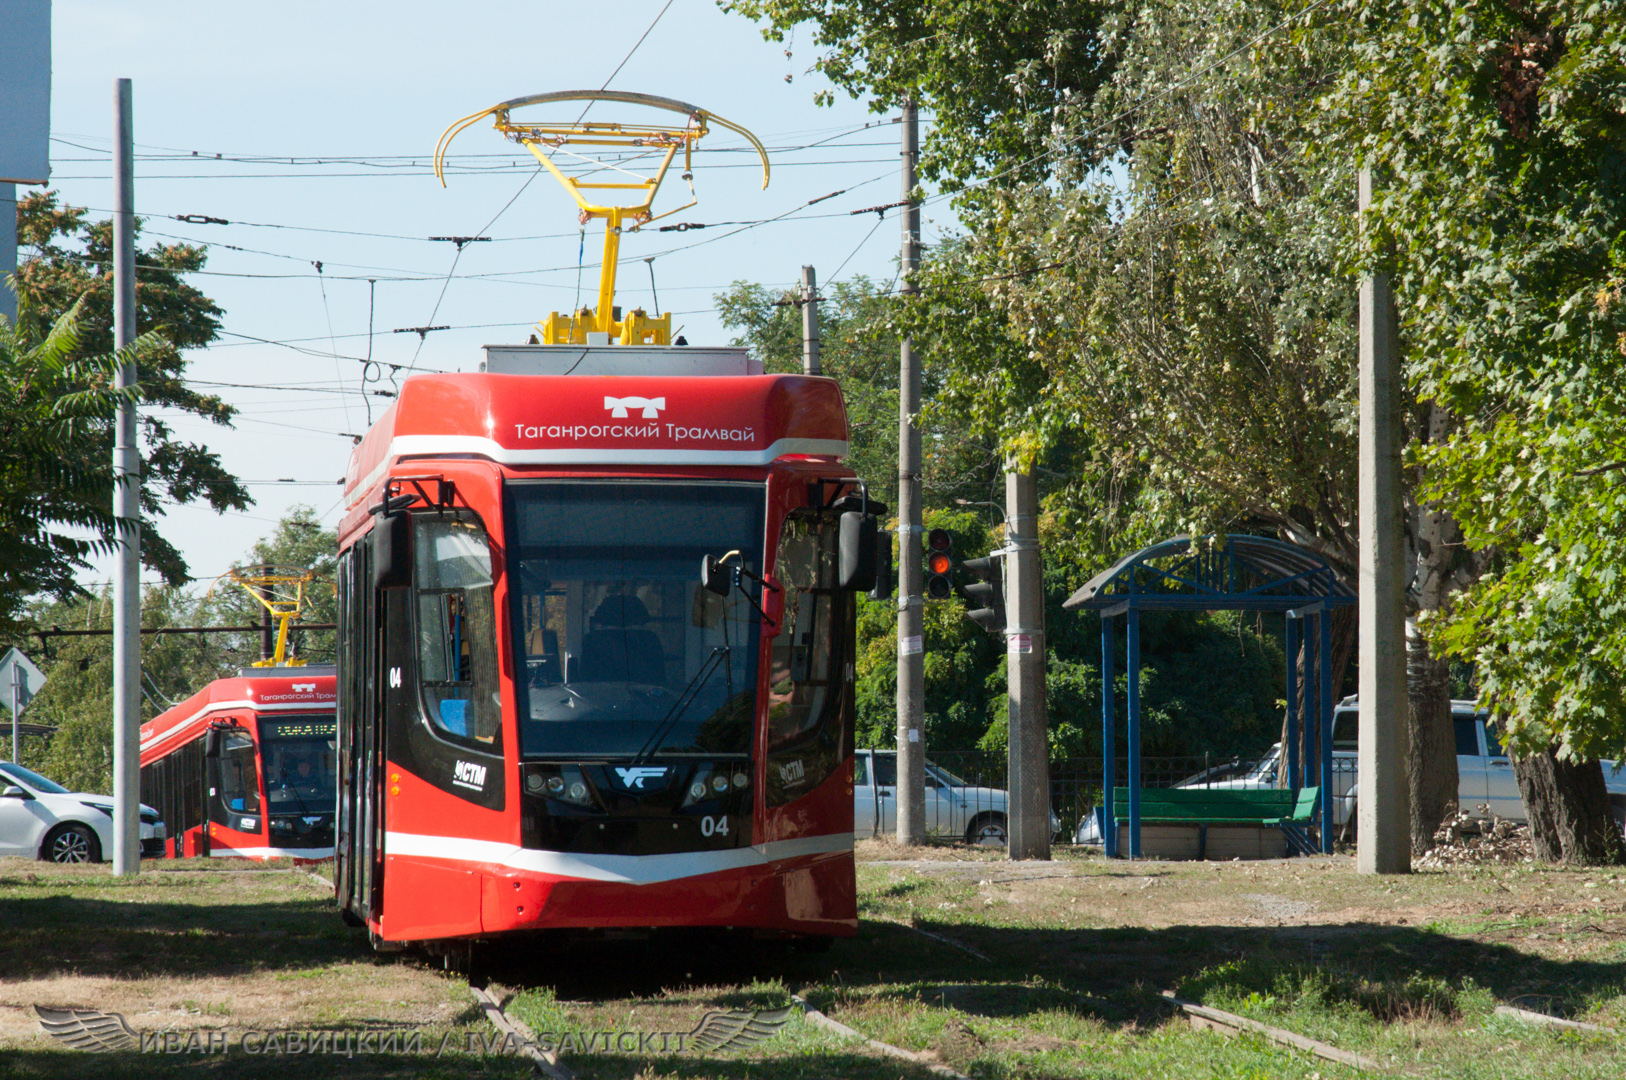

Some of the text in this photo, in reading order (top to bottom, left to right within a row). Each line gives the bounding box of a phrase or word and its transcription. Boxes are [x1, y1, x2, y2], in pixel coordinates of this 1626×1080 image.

[514, 422, 755, 443] Таганрогский Трамвай
[389, 667, 402, 689] 04
[260, 692, 314, 701] Таганрогский
[700, 815, 729, 837] 04
